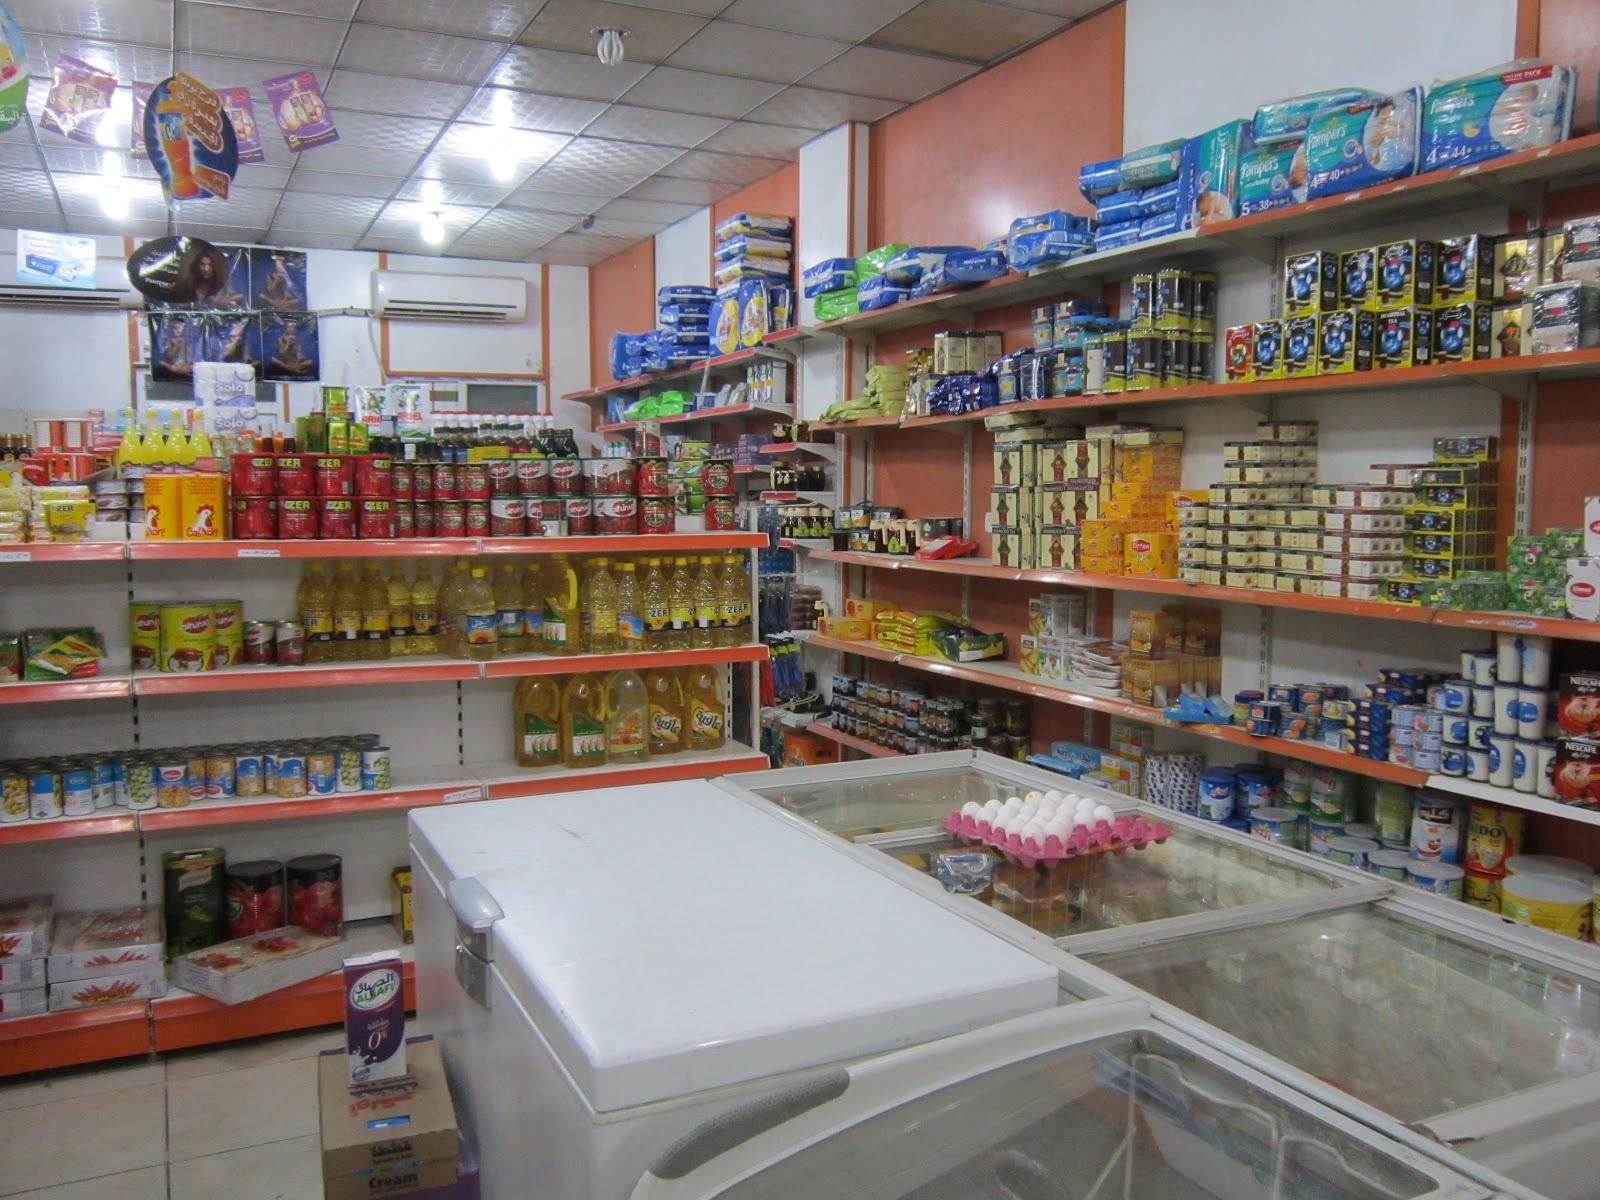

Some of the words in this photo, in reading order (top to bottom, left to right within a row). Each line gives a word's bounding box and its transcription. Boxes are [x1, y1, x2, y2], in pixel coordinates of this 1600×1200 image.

[1307, 125, 1347, 151] Pampers
[1426, 147, 1437, 163] 4
[1451, 145, 1466, 158] 44
[1241, 160, 1279, 179] Pampers
[1310, 174, 1319, 188] 4
[1329, 168, 1340, 180] 40
[1241, 202, 1251, 216] 5
[1259, 200, 1270, 211] 38
[215, 382, 244, 393] Solo
[215, 418, 244, 429] Solo
[1132, 540, 1150, 550] Lipton
[654, 714, 680, 733] عافية
[696, 710, 721, 730] عافية
[1565, 741, 1597, 754] NESCAFE
[369, 1172, 418, 1190] Cream
